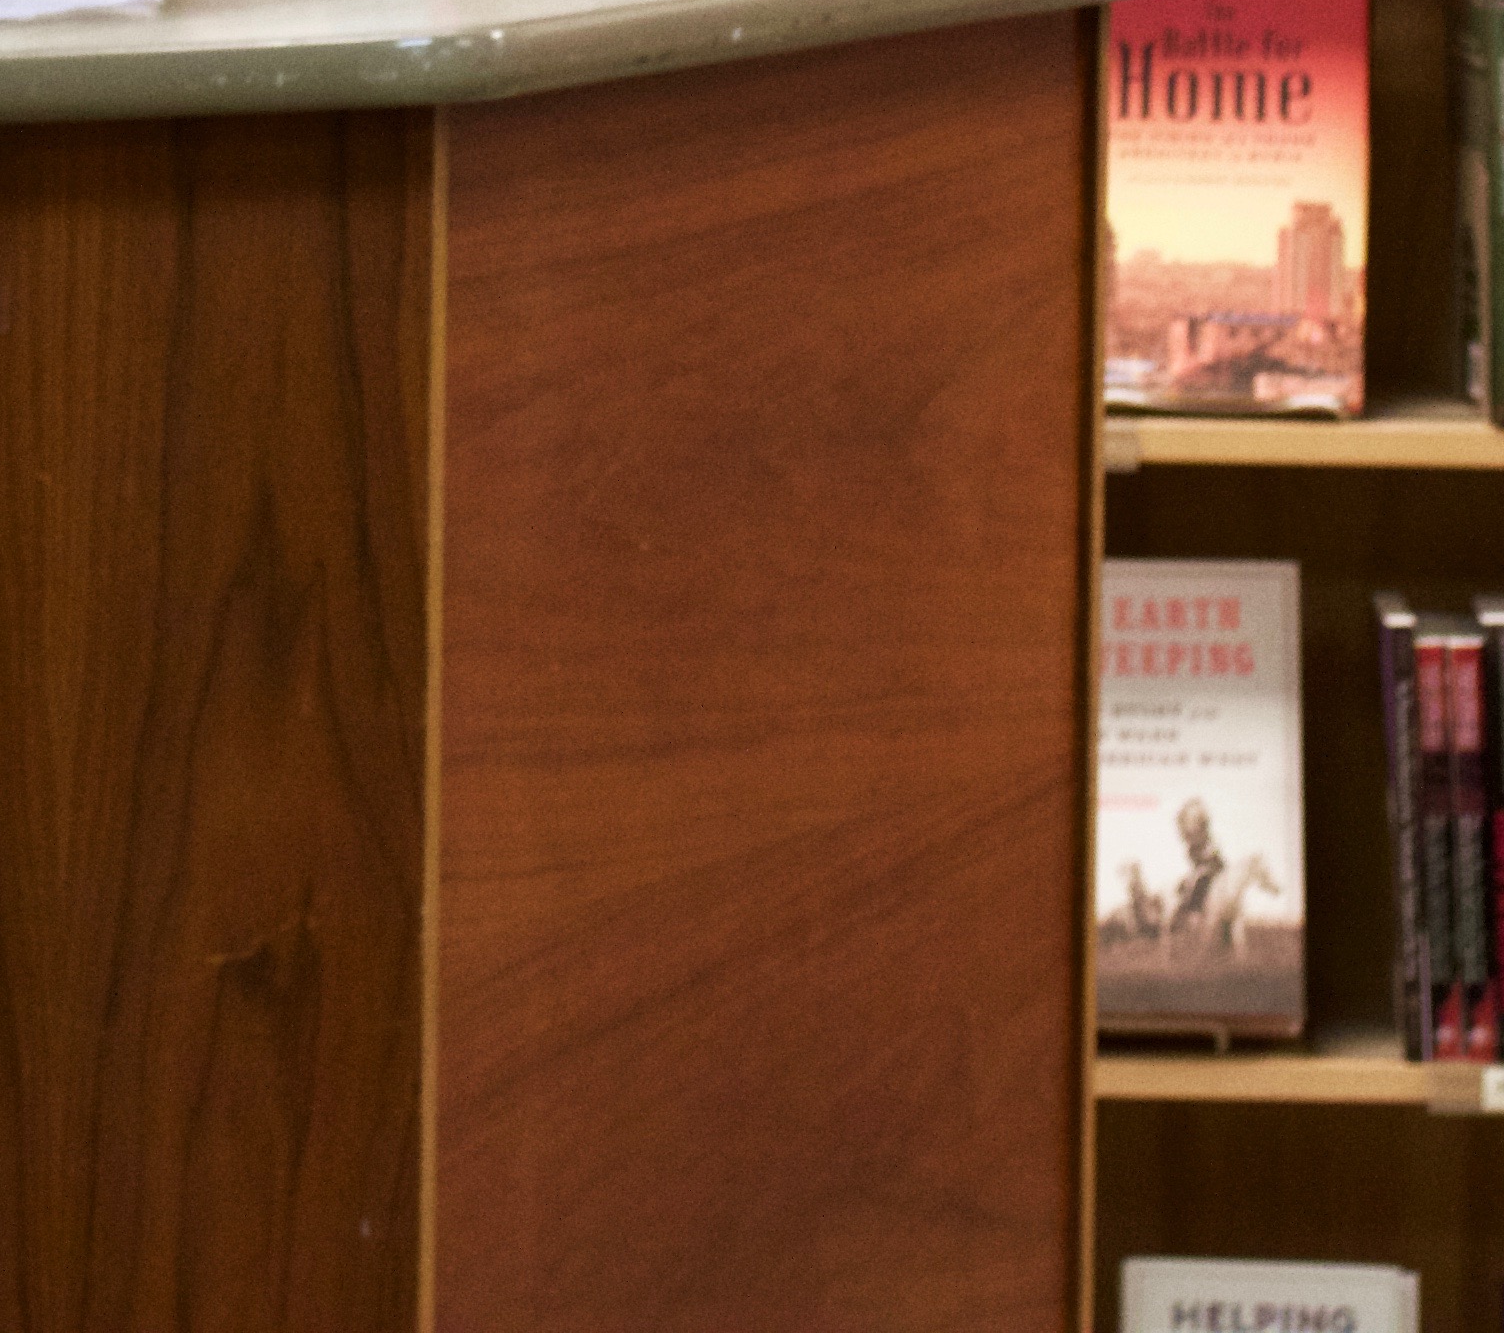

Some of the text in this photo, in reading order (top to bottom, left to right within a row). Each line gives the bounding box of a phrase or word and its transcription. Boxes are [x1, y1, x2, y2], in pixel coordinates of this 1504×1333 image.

[1161, 26, 1309, 59] Battle for
[1114, 39, 1314, 124] Home
[1112, 596, 1242, 633] EARTH
[1170, 1299, 1356, 1333] HELPING
